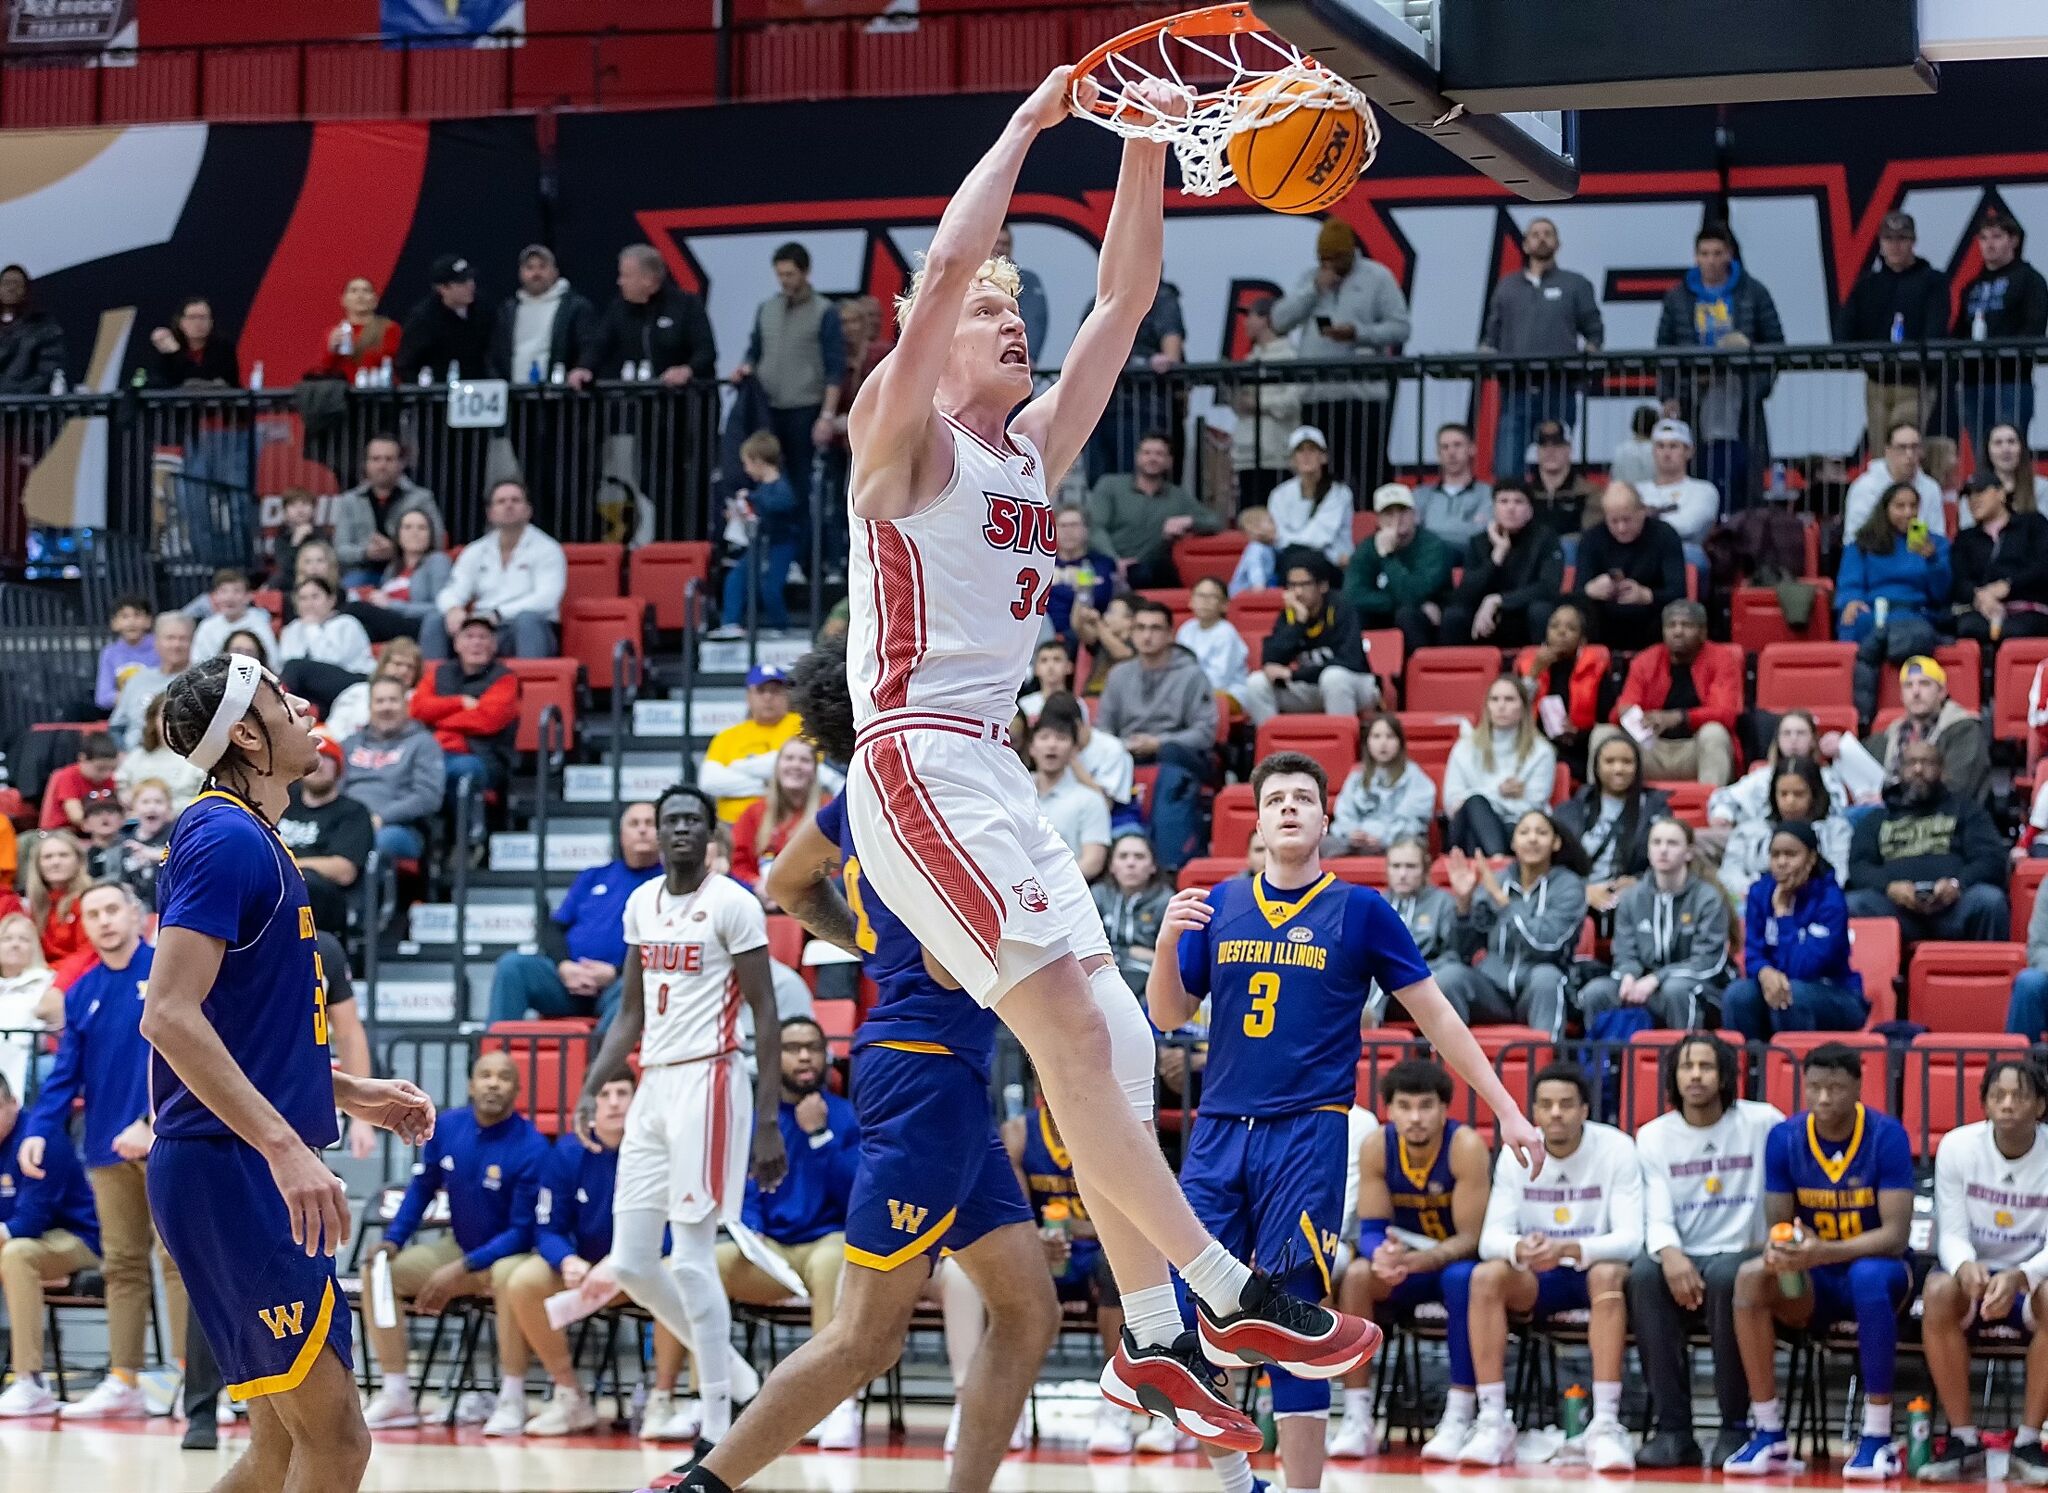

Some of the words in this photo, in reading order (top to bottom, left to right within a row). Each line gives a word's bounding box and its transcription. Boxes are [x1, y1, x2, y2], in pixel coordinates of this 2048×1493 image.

[1306, 121, 1350, 187] NCAA
[457, 391, 499, 417] 104
[640, 942, 704, 976] SIUE
[1217, 939, 1274, 965] WESTERN
[1273, 941, 1328, 971] ILLINOIS
[658, 983, 670, 1016] 0
[1242, 971, 1281, 1038] 3
[887, 1198, 929, 1235] W
[258, 1300, 305, 1340] W
